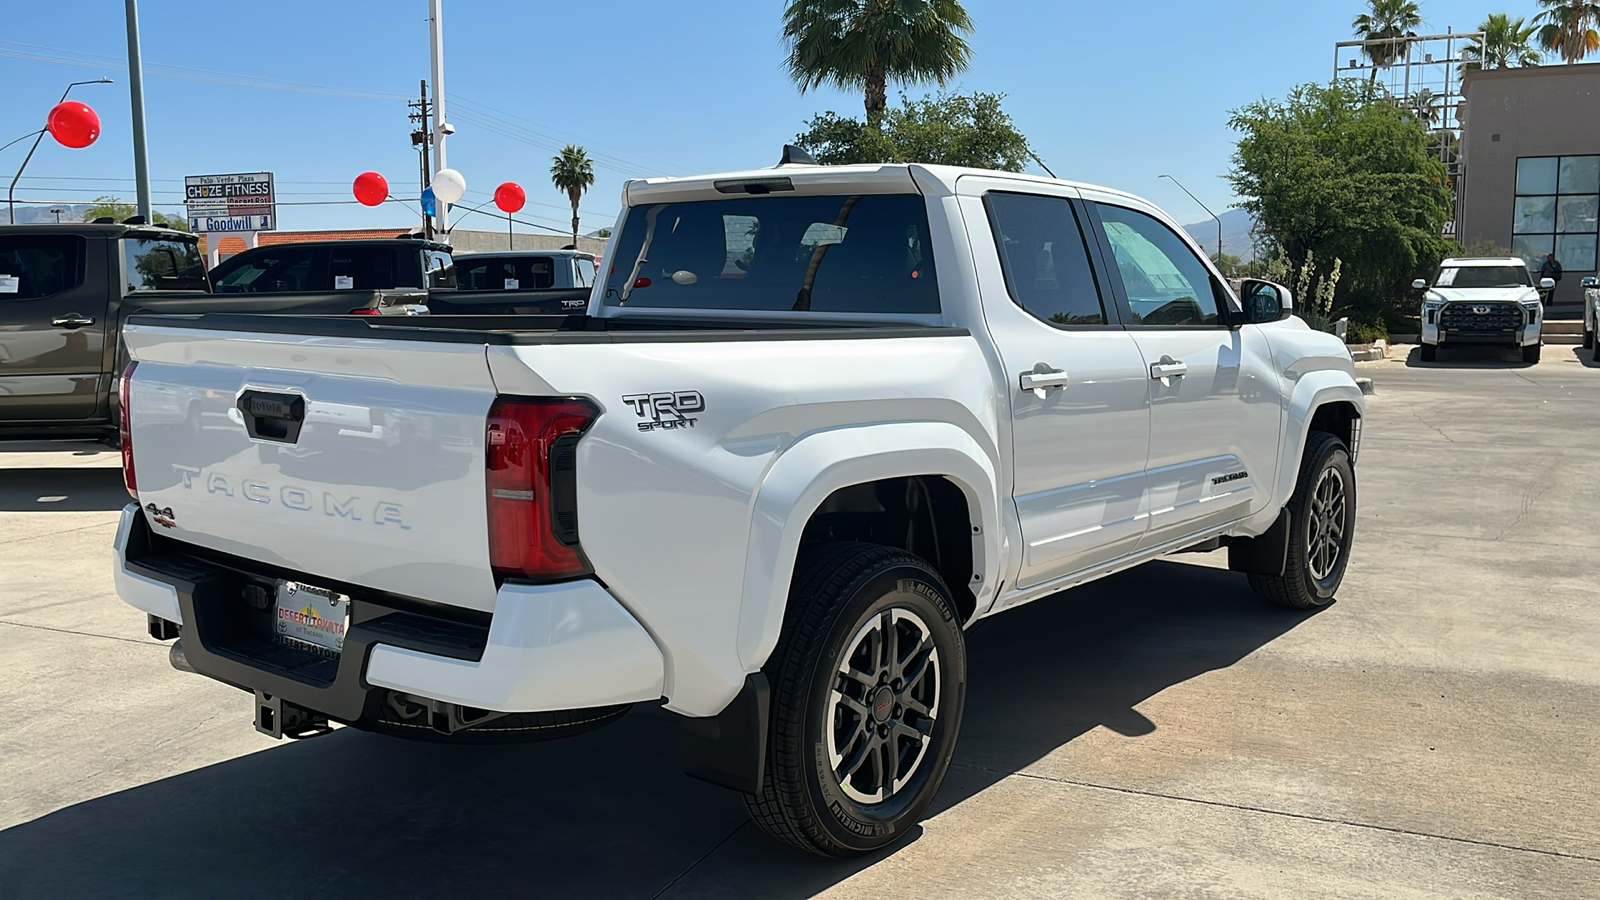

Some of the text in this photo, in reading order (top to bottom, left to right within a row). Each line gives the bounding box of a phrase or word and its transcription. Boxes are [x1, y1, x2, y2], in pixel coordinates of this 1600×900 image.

[225, 183, 269, 196] FITNESS
[206, 216, 252, 231] Goodwill
[252, 401, 282, 413] TOYOTA
[621, 390, 706, 421] TRD
[637, 418, 699, 432] SPORT
[1211, 471, 1248, 485] TACOMA
[172, 463, 411, 530] TACOMA
[915, 583, 952, 620] MICHELIN
[278, 608, 345, 636] DESERT TOYOTA
[303, 627, 324, 639] Tucson
[832, 804, 874, 836] MICHELIN
